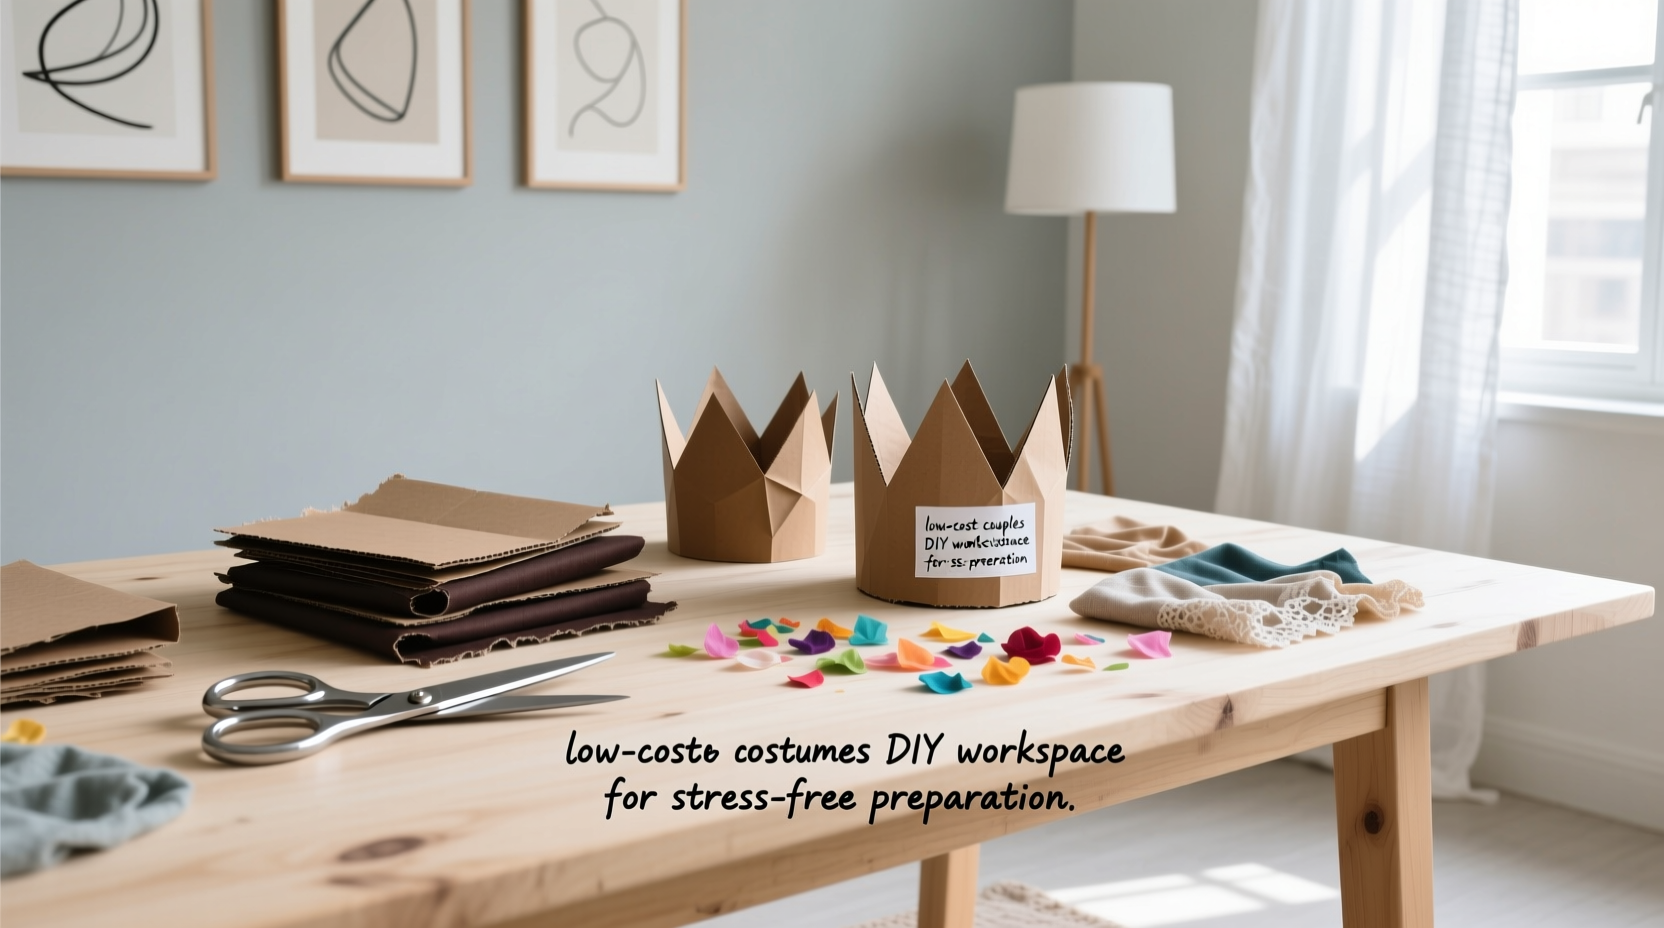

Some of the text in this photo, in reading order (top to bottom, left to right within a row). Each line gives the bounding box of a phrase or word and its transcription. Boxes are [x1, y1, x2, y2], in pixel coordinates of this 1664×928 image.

[925, 515, 1025, 536] low-cost couples
[925, 536, 949, 550] DIY
